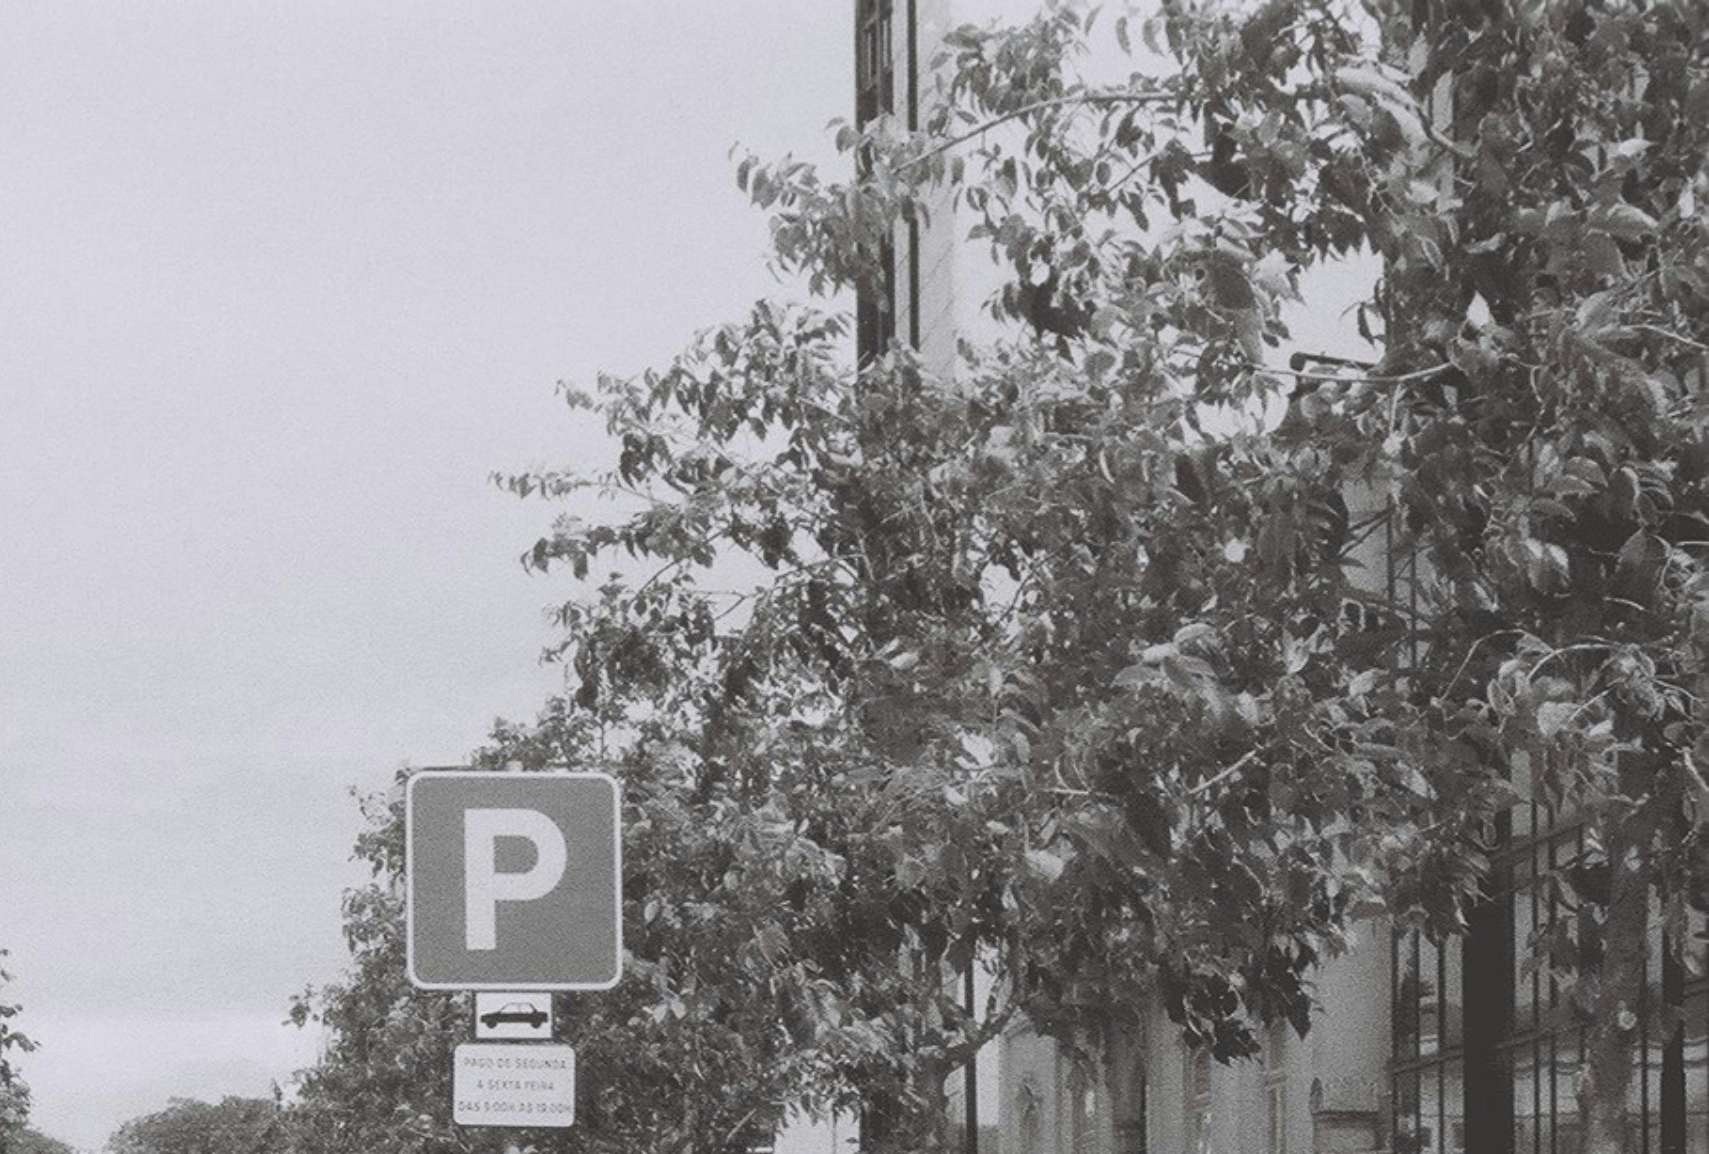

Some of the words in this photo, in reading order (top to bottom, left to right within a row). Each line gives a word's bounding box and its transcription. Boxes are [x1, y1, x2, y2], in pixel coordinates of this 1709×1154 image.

[464, 808, 568, 951] P
[464, 1057, 494, 1069] PAGO
[497, 1057, 511, 1069] DE
[515, 1057, 567, 1070] SEGUNDA
[488, 1079, 522, 1091] SEXTA
[458, 1101, 481, 1112] DAS
